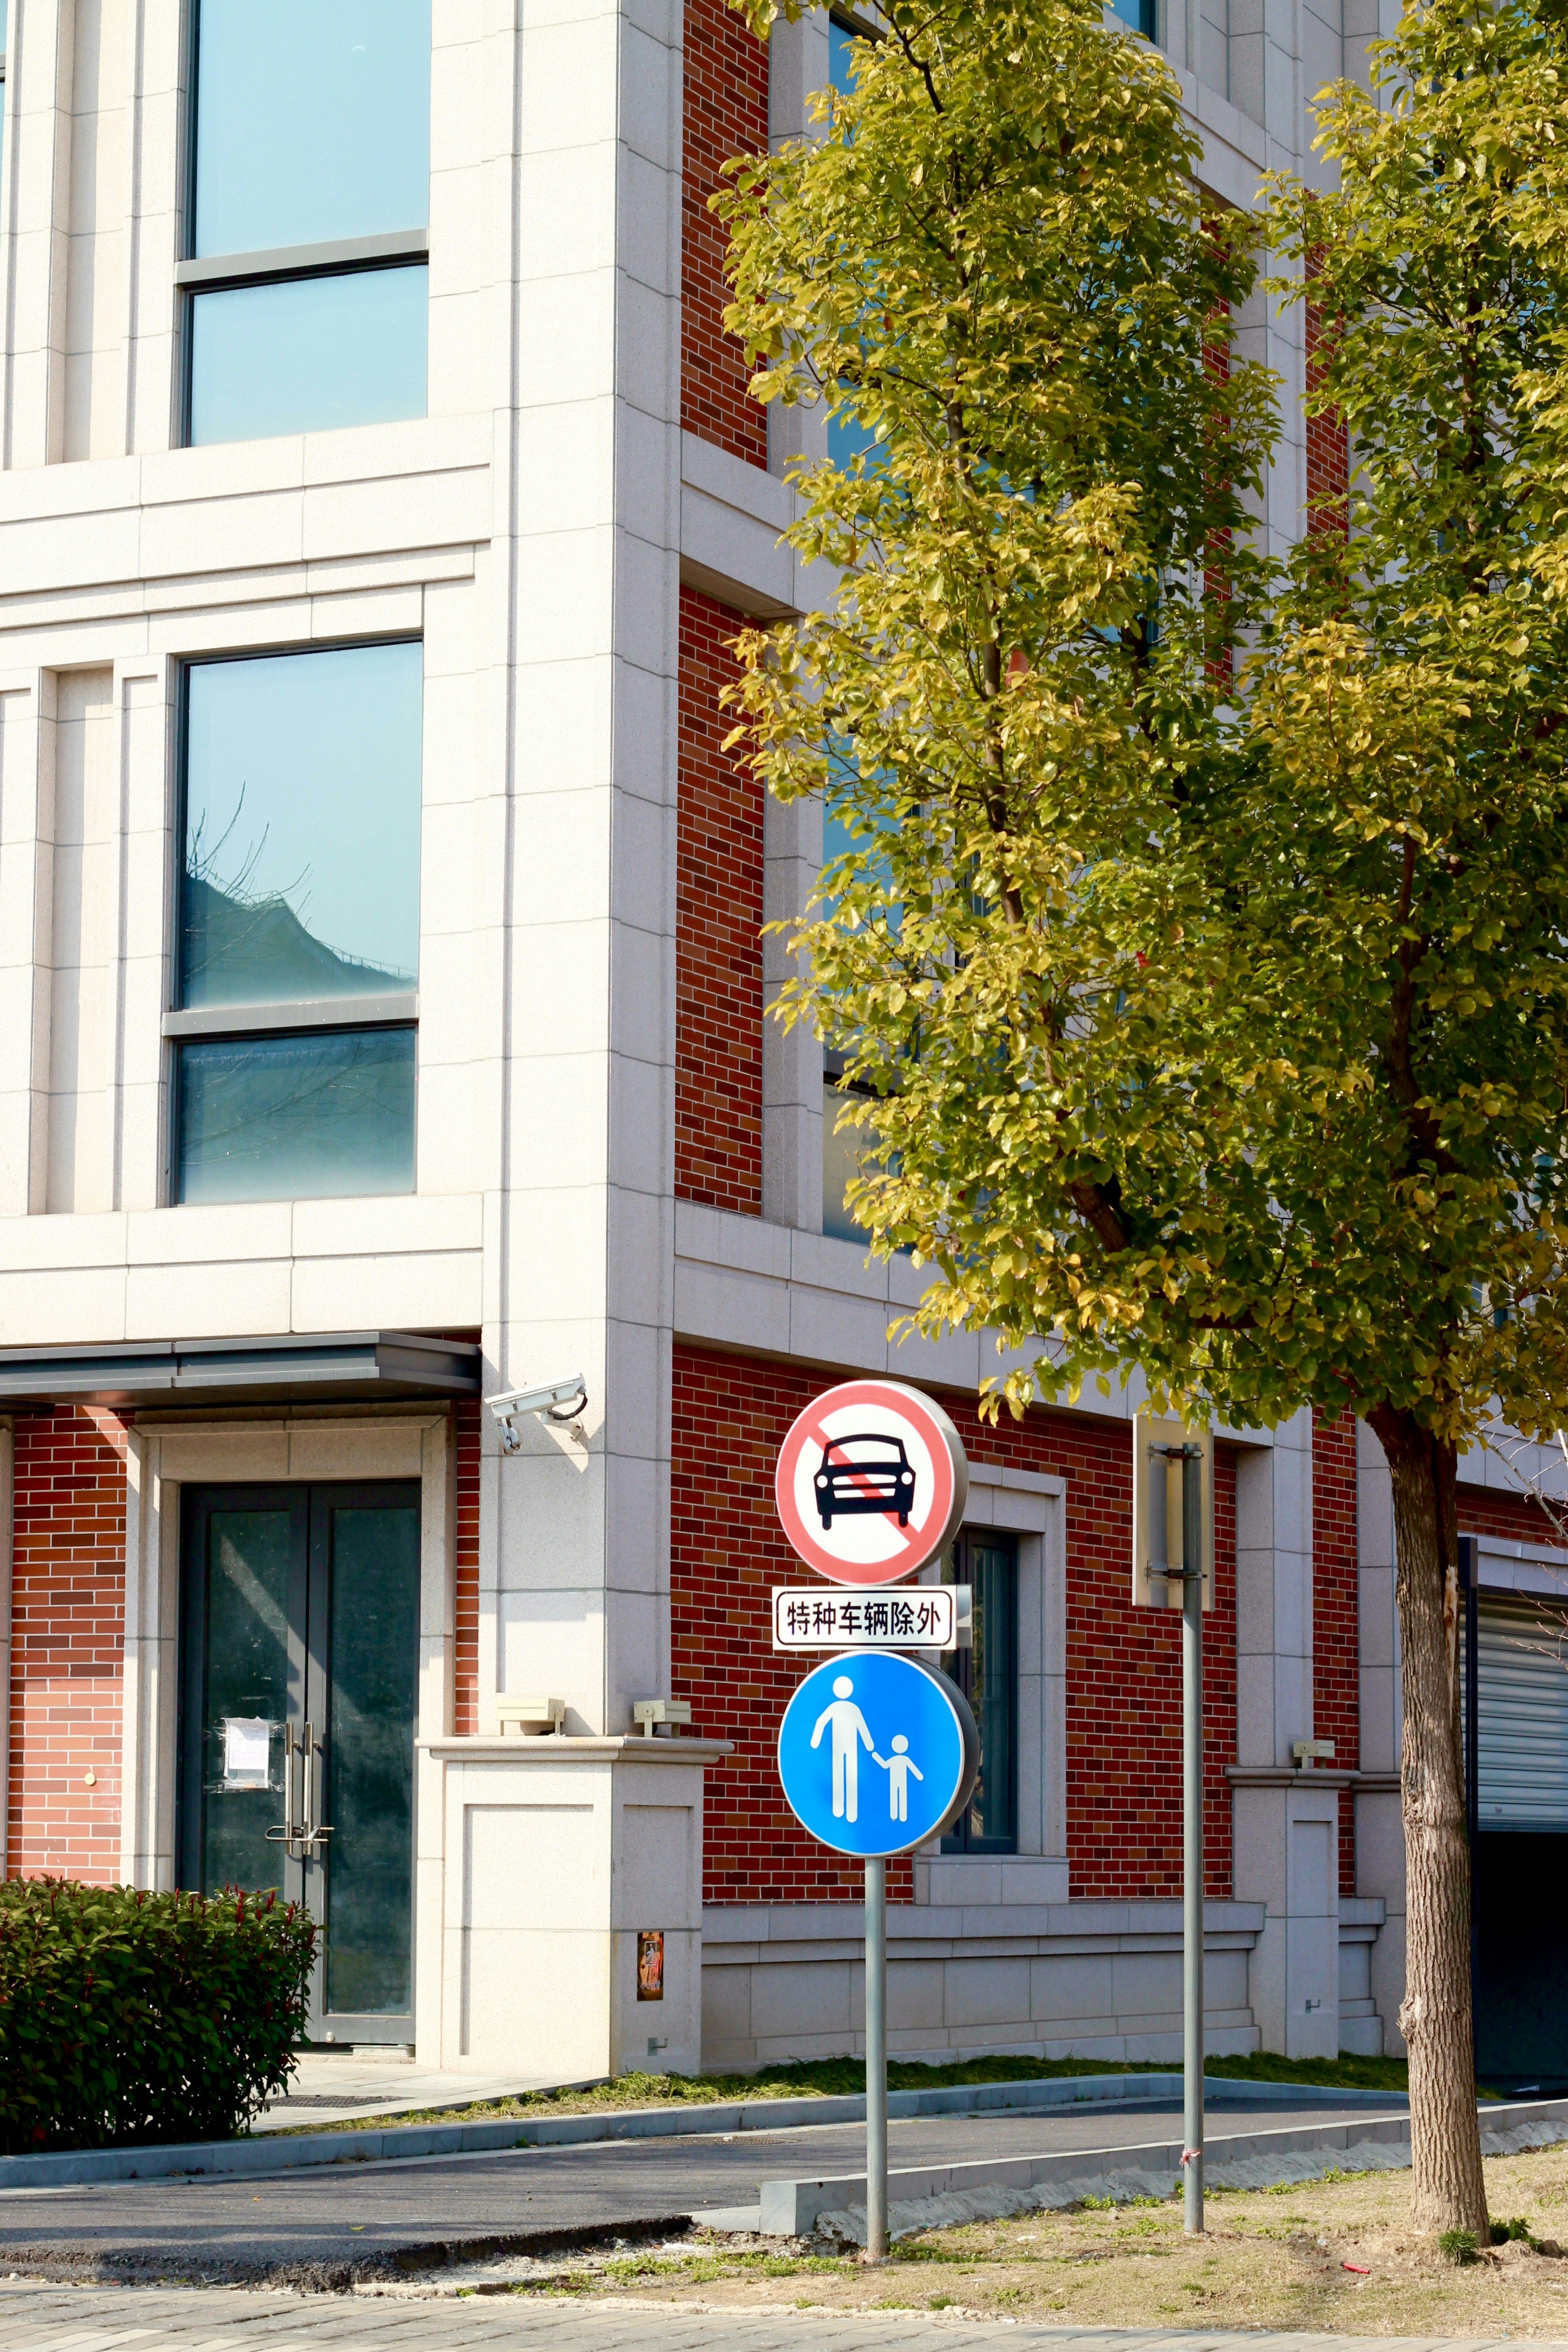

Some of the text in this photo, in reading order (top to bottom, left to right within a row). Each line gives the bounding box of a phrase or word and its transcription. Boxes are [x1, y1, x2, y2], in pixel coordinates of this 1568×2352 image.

[787, 1601, 940, 1636] 特种车辆除外
